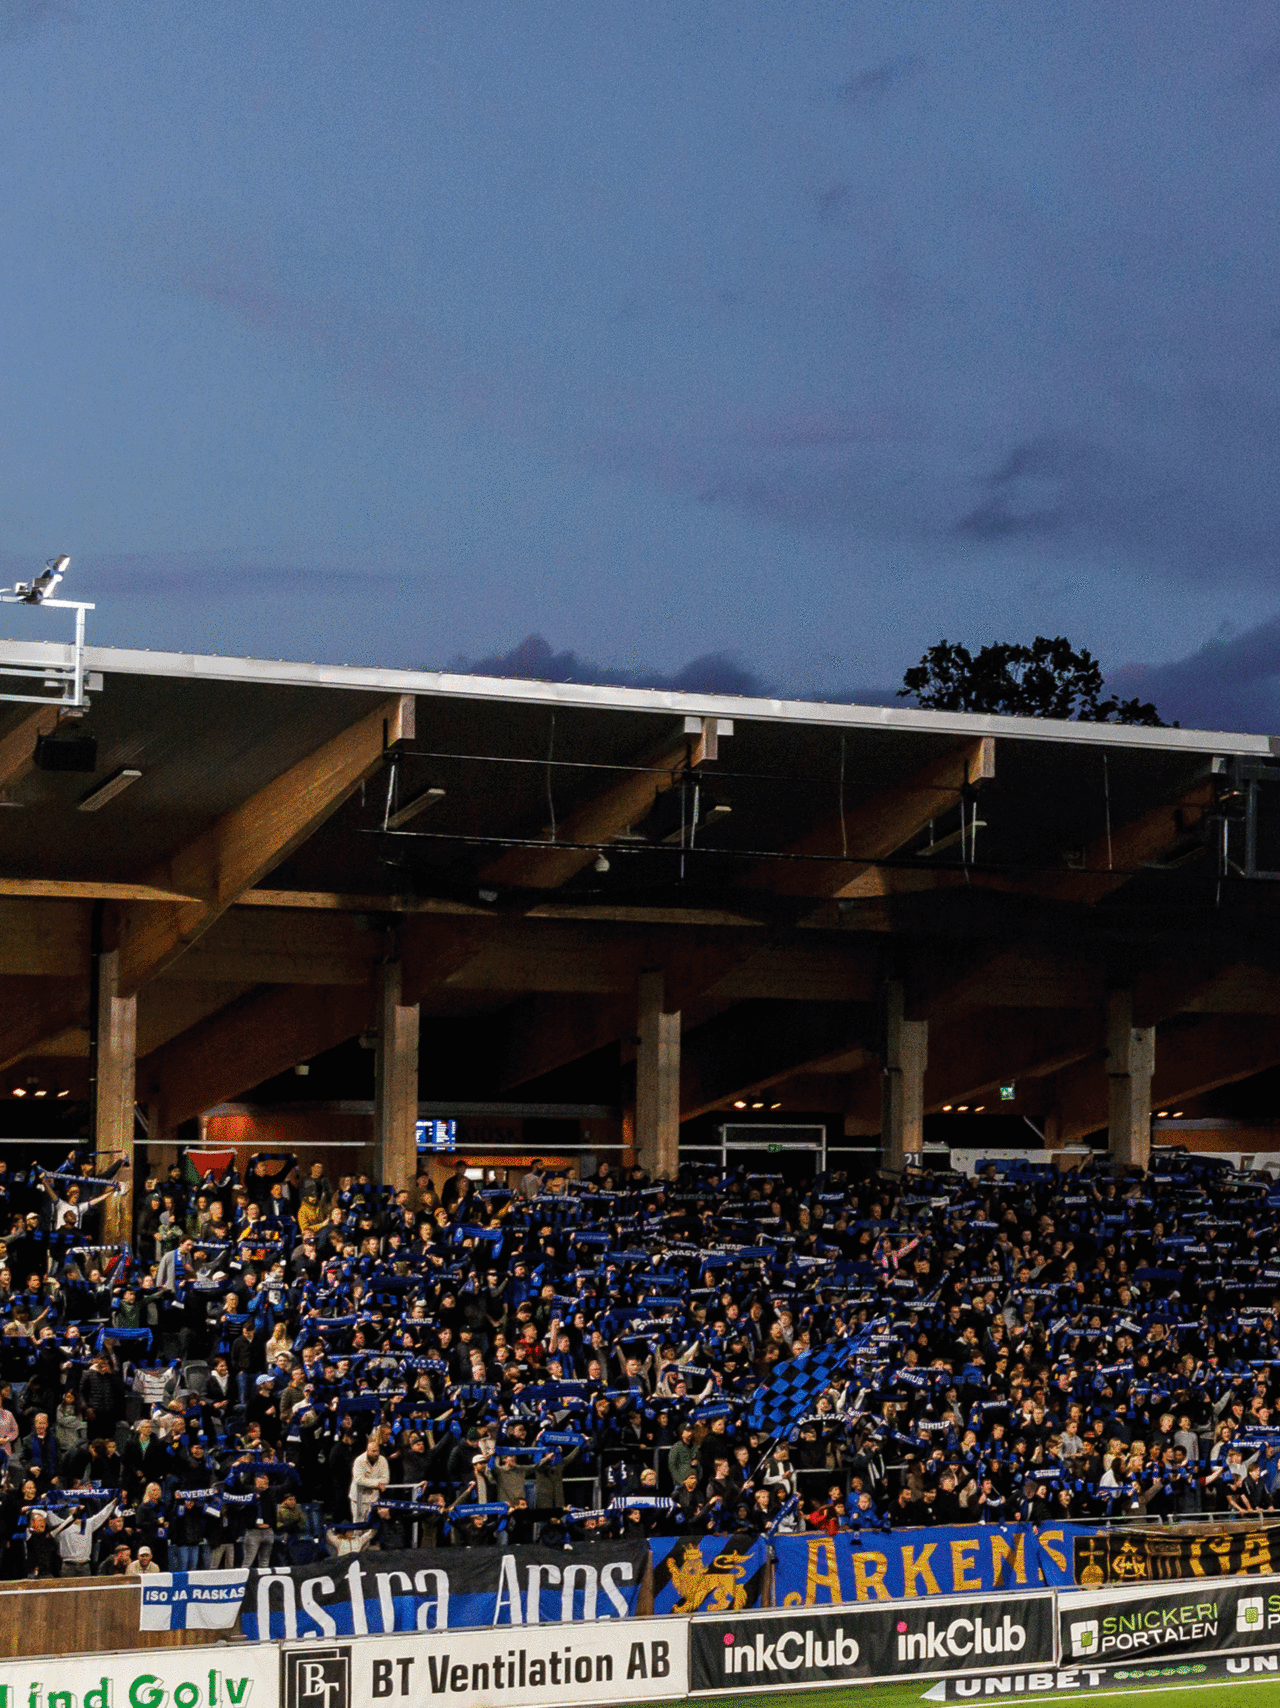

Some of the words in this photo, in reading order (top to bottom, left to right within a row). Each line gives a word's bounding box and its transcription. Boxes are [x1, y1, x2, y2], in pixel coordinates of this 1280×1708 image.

[904, 1153, 920, 1166] 21
[918, 1421, 950, 1430] SIRIUS
[146, 1590, 168, 1601] ISO
[172, 1589, 188, 1601] JA
[192, 1586, 245, 1600] RASKAS
[494, 1555, 633, 1625] Aros
[1102, 1603, 1218, 1635] SNICKERI
[723, 1631, 860, 1674] inkClub
[896, 1615, 1026, 1661] inkClub
[1101, 1621, 1218, 1652] PORTALEN
[372, 1656, 415, 1699] BT
[428, 1647, 614, 1694] Ventilation
[626, 1640, 671, 1683] AB
[955, 1669, 1105, 1698] UNIBET
[128, 1669, 250, 1708] Golv
